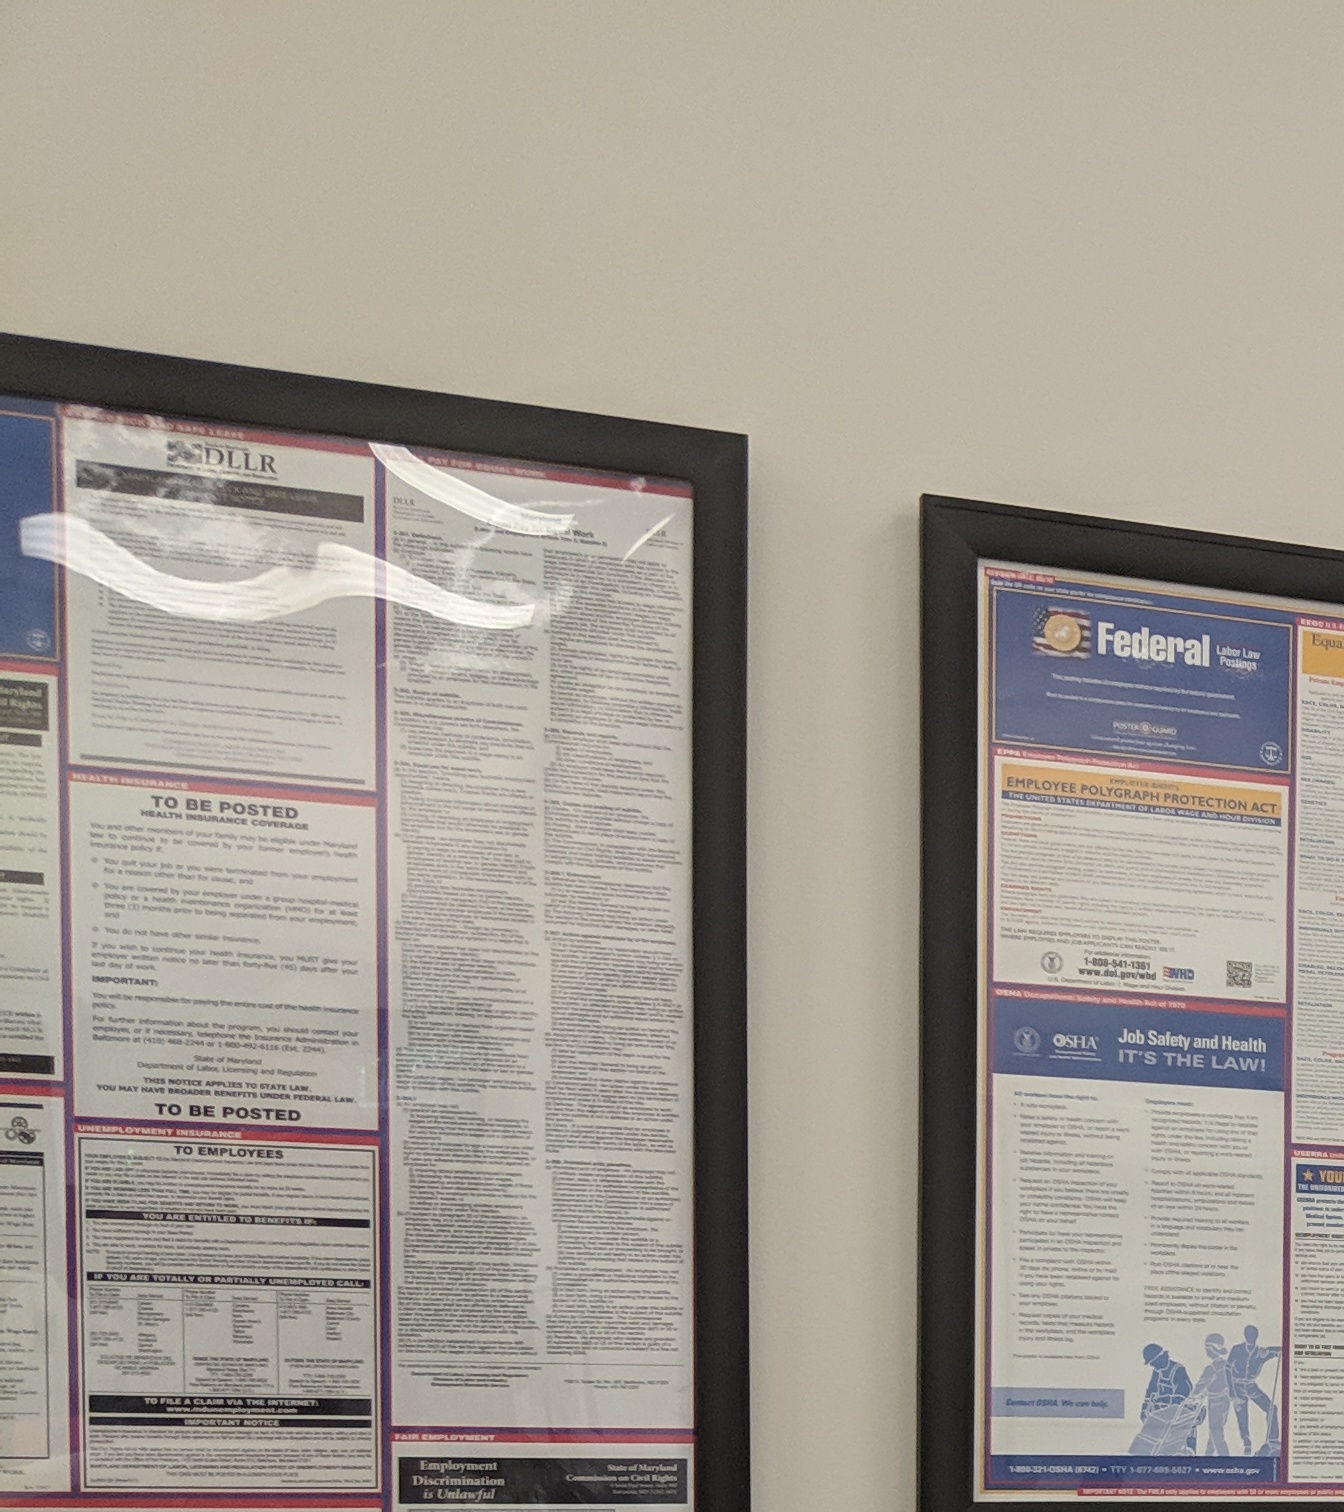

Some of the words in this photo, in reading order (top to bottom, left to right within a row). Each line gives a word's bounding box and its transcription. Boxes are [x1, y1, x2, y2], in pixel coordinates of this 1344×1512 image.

[204, 447, 278, 474] DLLR
[1097, 621, 1210, 667] Federal
[1216, 644, 1241, 658] Labor
[1242, 647, 1261, 660] Law
[1219, 656, 1257, 671] Postings
[1006, 776, 1076, 793] EMPLOYEE
[1080, 784, 1159, 802] POLYGRAPH
[1163, 792, 1248, 811] PROTECTION
[1251, 801, 1277, 814] ACT
[151, 795, 178, 809] TO
[186, 799, 213, 812] BE
[219, 801, 298, 820] POSTED
[140, 809, 183, 821] HEALTH
[186, 813, 248, 826] INSURANCE
[252, 818, 309, 830] COVERAGE
[1053, 1034, 1098, 1050] OSHA
[1118, 1027, 1144, 1045] Job
[1147, 1029, 1191, 1050] Safety
[1193, 1033, 1217, 1049] and
[1221, 1035, 1267, 1053] Health
[1118, 1049, 1157, 1065] IT'S
[1163, 1052, 1205, 1068] THE
[1211, 1055, 1266, 1072] LAW!
[154, 1103, 181, 1115] TO
[189, 1104, 215, 1117] BE
[222, 1106, 301, 1121] POSTED
[77, 1125, 174, 1137] UNEMPLOYMENT
[176, 1129, 241, 1139] INSURANCE
[174, 1145, 193, 1156] TO
[198, 1147, 283, 1159] EMPLOYEES
[160, 1398, 182, 1406] FILE
[184, 1398, 192, 1406] A
[194, 1398, 224, 1407] CLAIM
[226, 1399, 244, 1407] VIA
[246, 1399, 265, 1407] THE
[184, 1419, 241, 1427] IMPORTANT
[419, 1460, 497, 1474] Employment
[608, 1464, 627, 1472] State
[629, 1464, 637, 1472] of
[639, 1464, 678, 1474] Maryland
[412, 1475, 505, 1487] Discrimination
[424, 1489, 434, 1499] is
[437, 1488, 495, 1500] Unlawful
